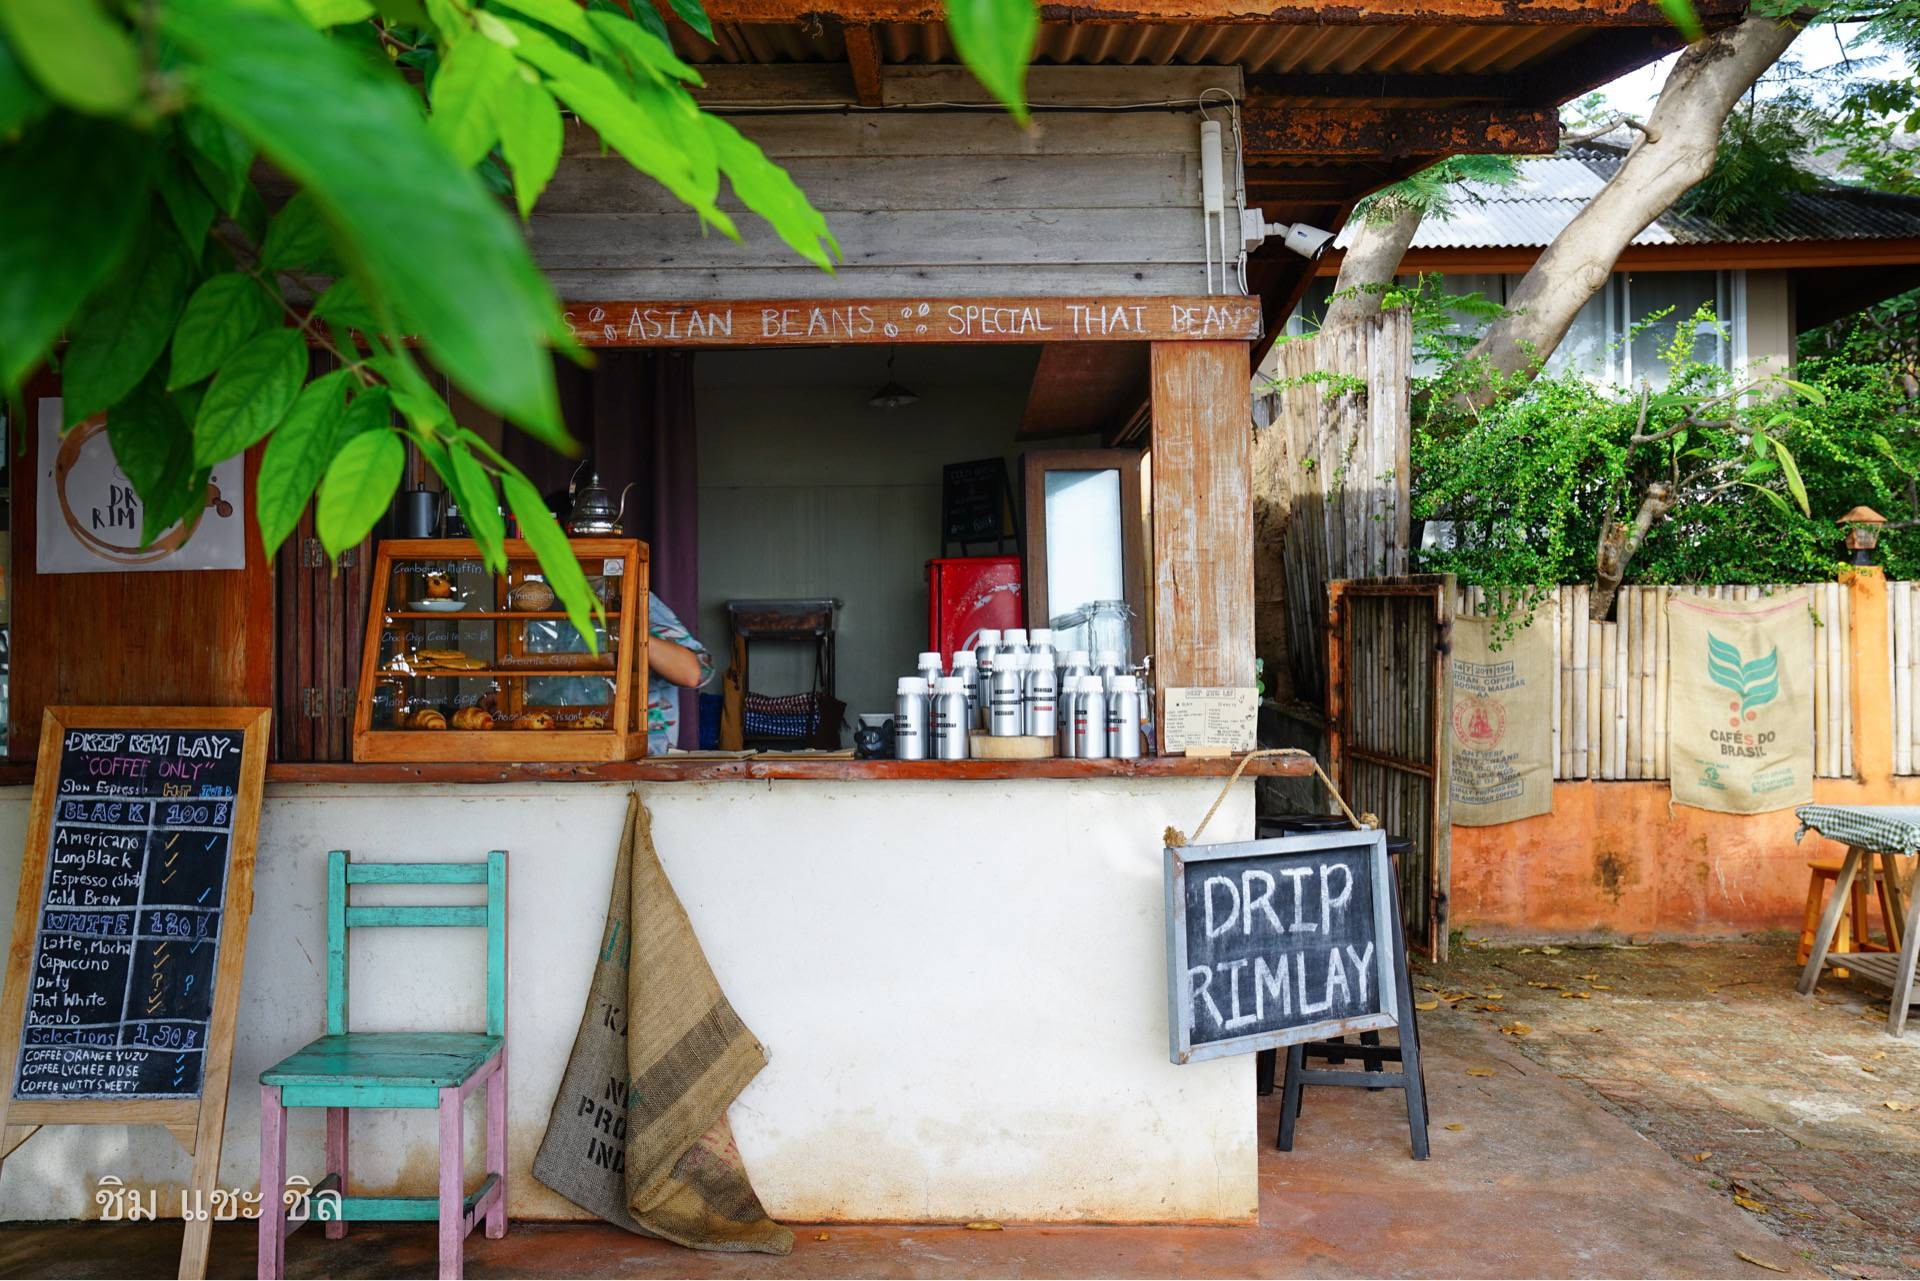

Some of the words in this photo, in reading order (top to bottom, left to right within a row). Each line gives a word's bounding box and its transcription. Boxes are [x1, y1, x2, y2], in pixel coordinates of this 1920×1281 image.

[627, 306, 733, 340] ASIAN
[761, 305, 875, 338] BEANS
[947, 304, 1054, 336] SPECIAL
[1065, 304, 1148, 335] THAI
[92, 505, 135, 530] RIM
[1454, 672, 1479, 684] DIAN
[1709, 729, 1754, 746] CAFÉS
[1757, 730, 1776, 745] DO
[1720, 743, 1767, 758] BRASIL
[64, 801, 145, 823] BLACK
[166, 804, 209, 824] 100
[56, 828, 139, 850] Americano
[52, 870, 108, 892] Espresso
[47, 889, 75, 905] Cold
[84, 888, 121, 906] Brew
[1203, 863, 1354, 938] DRIP
[47, 913, 130, 935] WHITE
[36, 975, 70, 992] Dirty
[1188, 941, 1374, 1030] RIMLAY
[32, 992, 59, 1008] Flat
[64, 992, 107, 1007] White
[31, 1027, 116, 1044] Selections
[25, 1049, 61, 1062] COFFEE
[63, 1048, 112, 1064] ORANGE
[115, 1050, 149, 1063] YUZU
[22, 1063, 59, 1076] COFFEE
[61, 1064, 104, 1078] LYCHEE
[108, 1064, 140, 1078] ROSE
[21, 1079, 59, 1092] COFFEE
[62, 1078, 96, 1092] NUTTY
